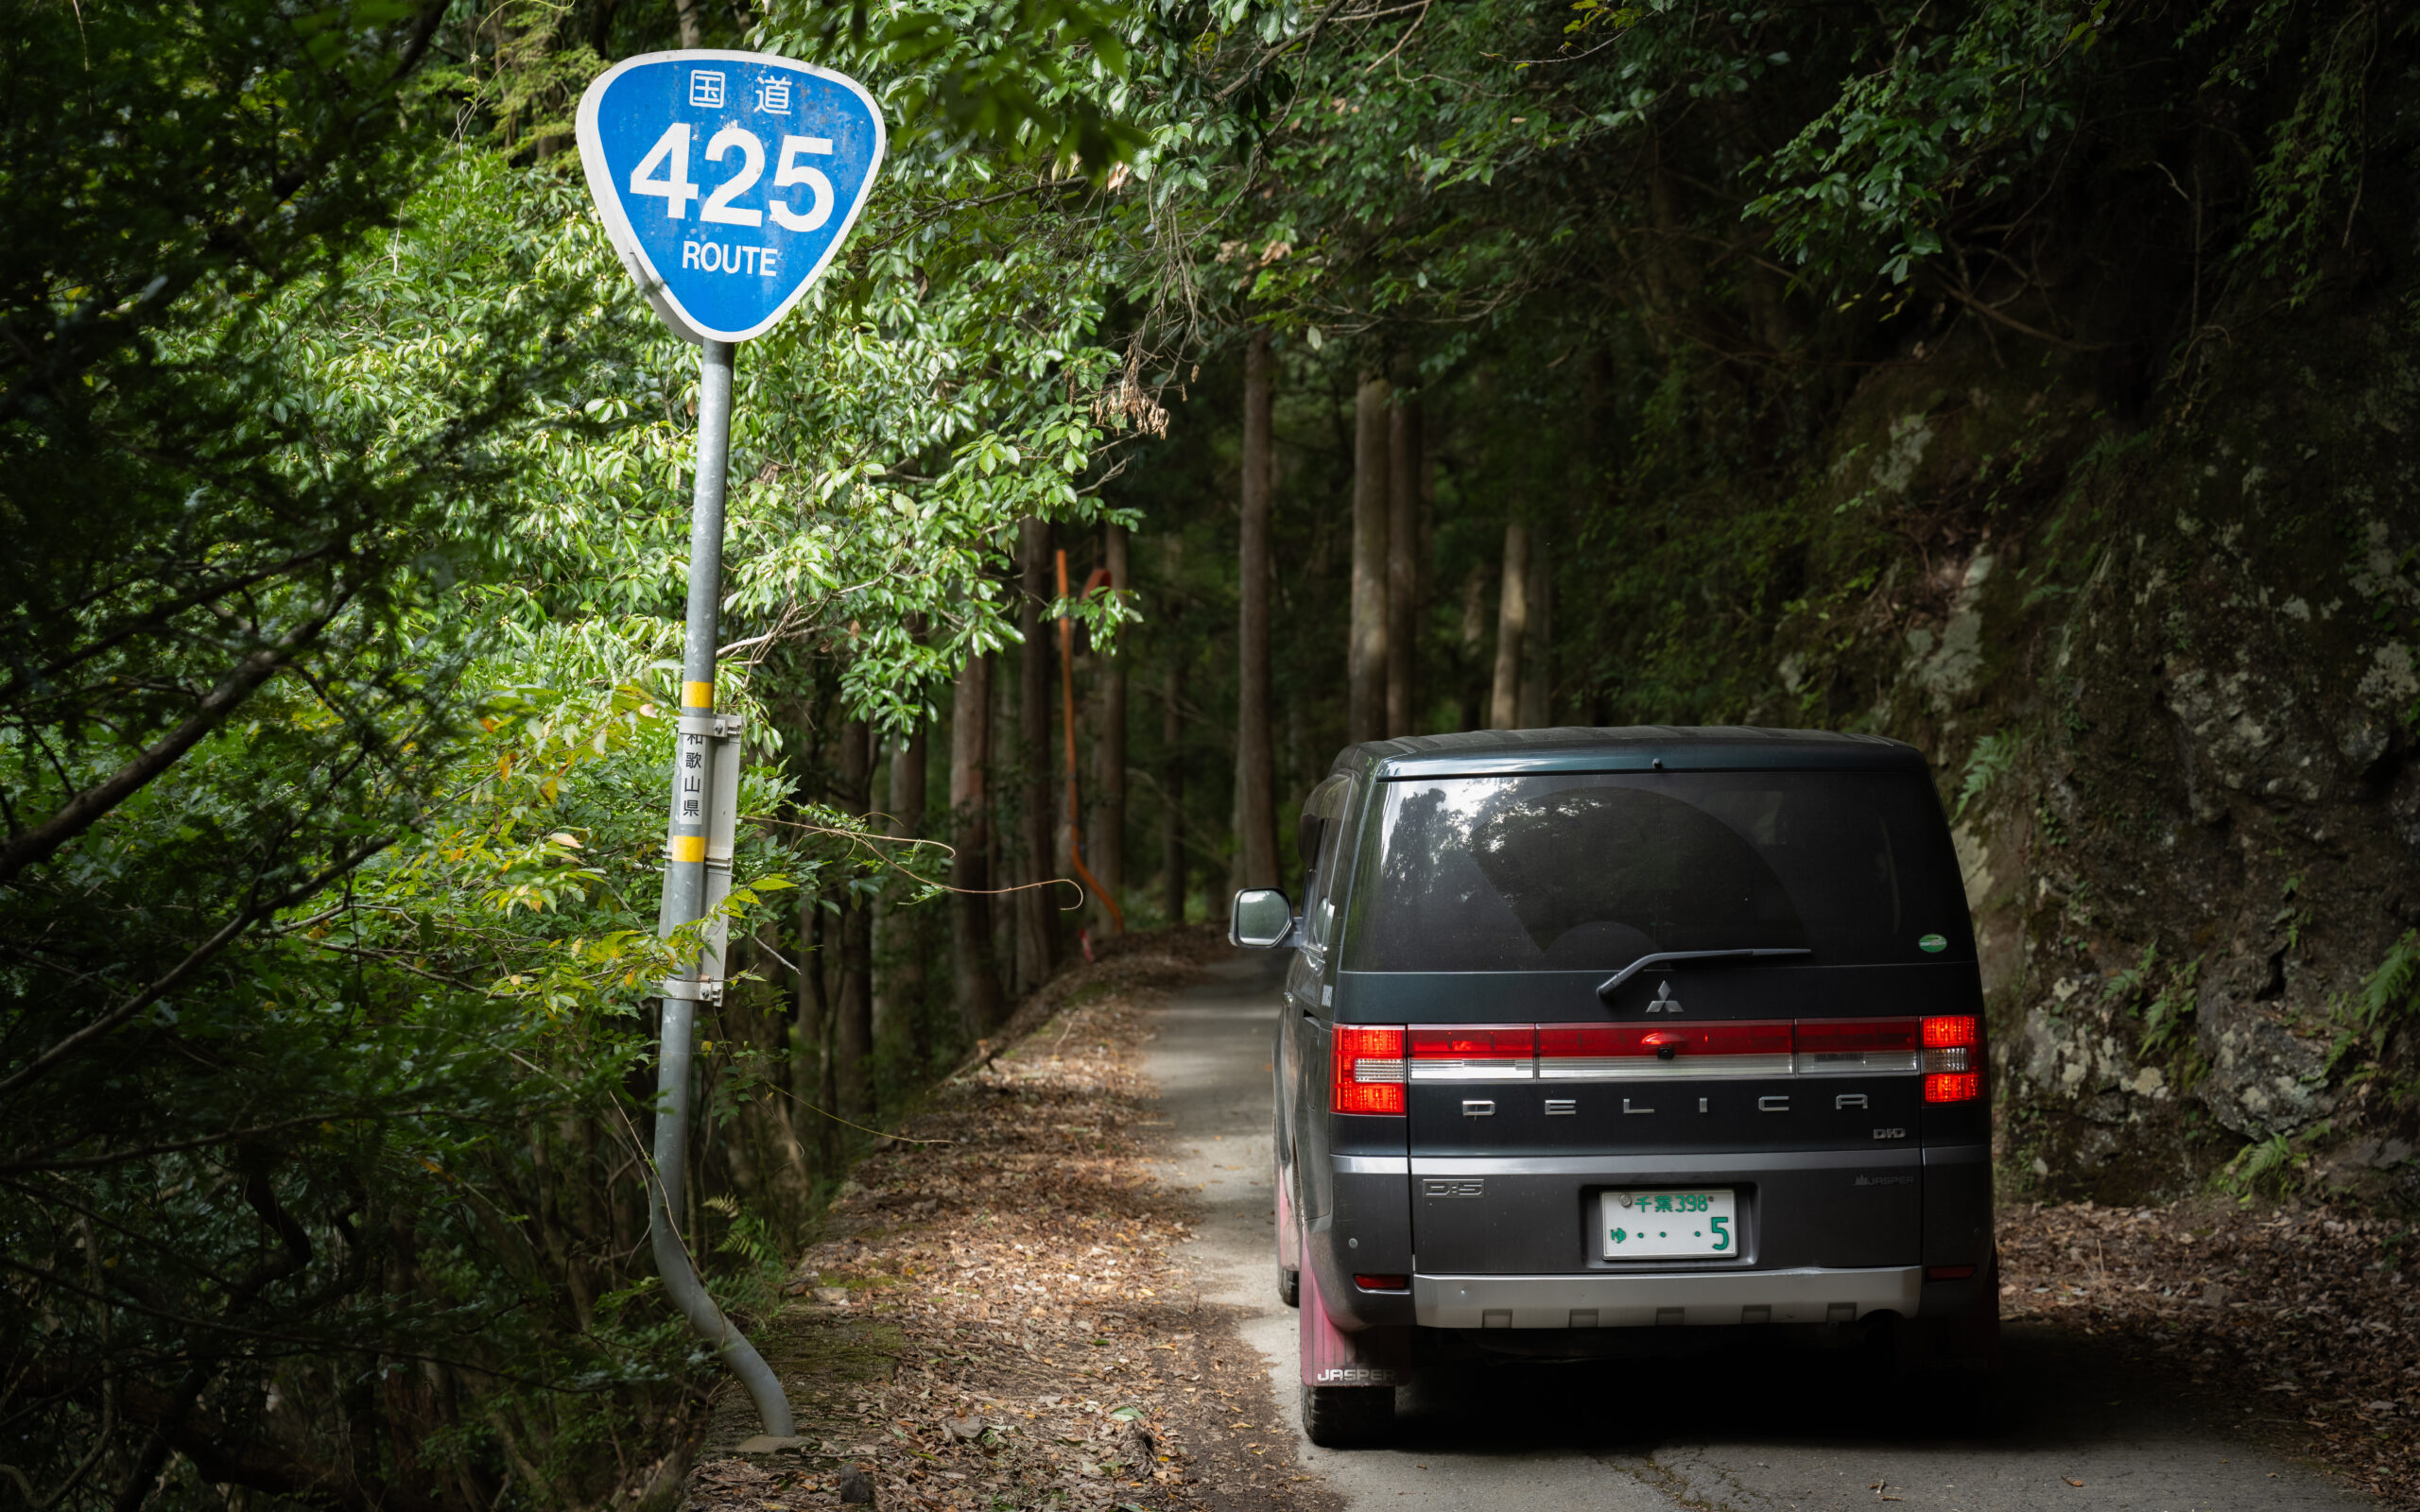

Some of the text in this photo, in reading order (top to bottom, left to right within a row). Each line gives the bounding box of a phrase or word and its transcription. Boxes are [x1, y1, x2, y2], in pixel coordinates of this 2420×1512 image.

[689, 69, 792, 115] 国道
[630, 122, 836, 232] 425
[682, 240, 778, 277] ROUTE
[683, 733, 703, 816] 和歌山県
[1462, 1093, 1869, 1117] DELICA
[1867, 1176, 1914, 1186] JASPER
[1317, 1368, 1396, 1382] JASPER
